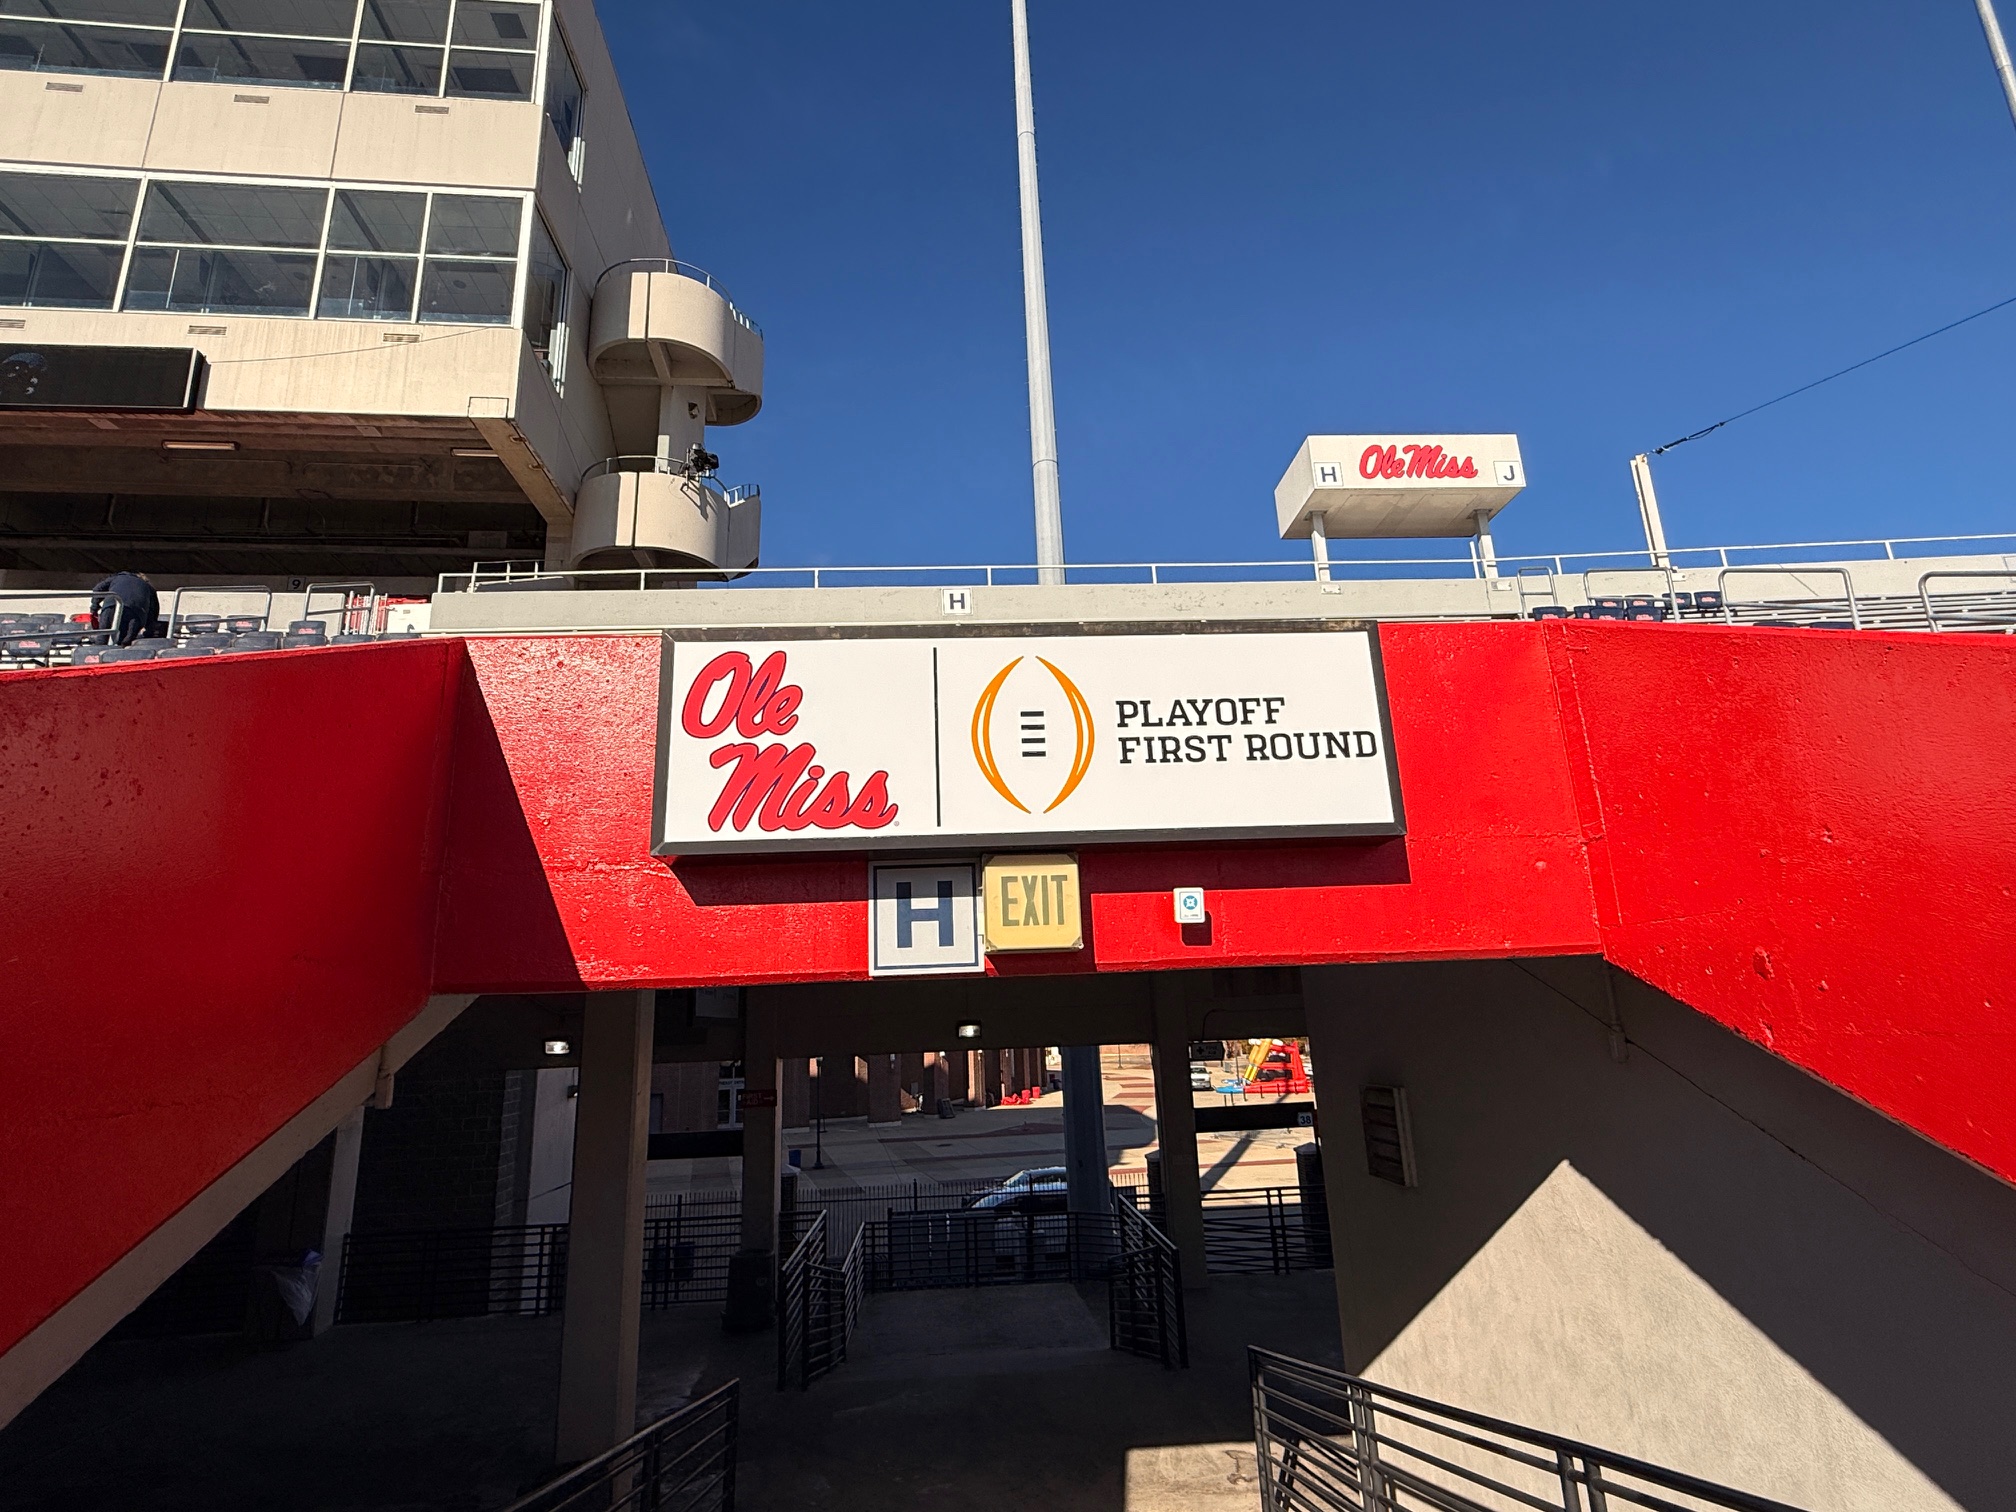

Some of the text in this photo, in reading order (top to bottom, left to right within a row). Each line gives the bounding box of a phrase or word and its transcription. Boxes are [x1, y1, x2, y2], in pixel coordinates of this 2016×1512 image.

[1320, 466, 1338, 482] H
[1359, 444, 1478, 479] Ole Miss
[1503, 465, 1516, 481] J
[291, 579, 301, 590] 9
[949, 592, 966, 610] H
[681, 650, 804, 739] Ole
[1115, 697, 1286, 728] PLAYOFF
[1118, 730, 1378, 764] FIRST ROUND
[707, 742, 899, 833] Miss
[895, 880, 955, 949] H
[1000, 874, 1068, 927] EXIT
[1299, 1115, 1312, 1125] 38
